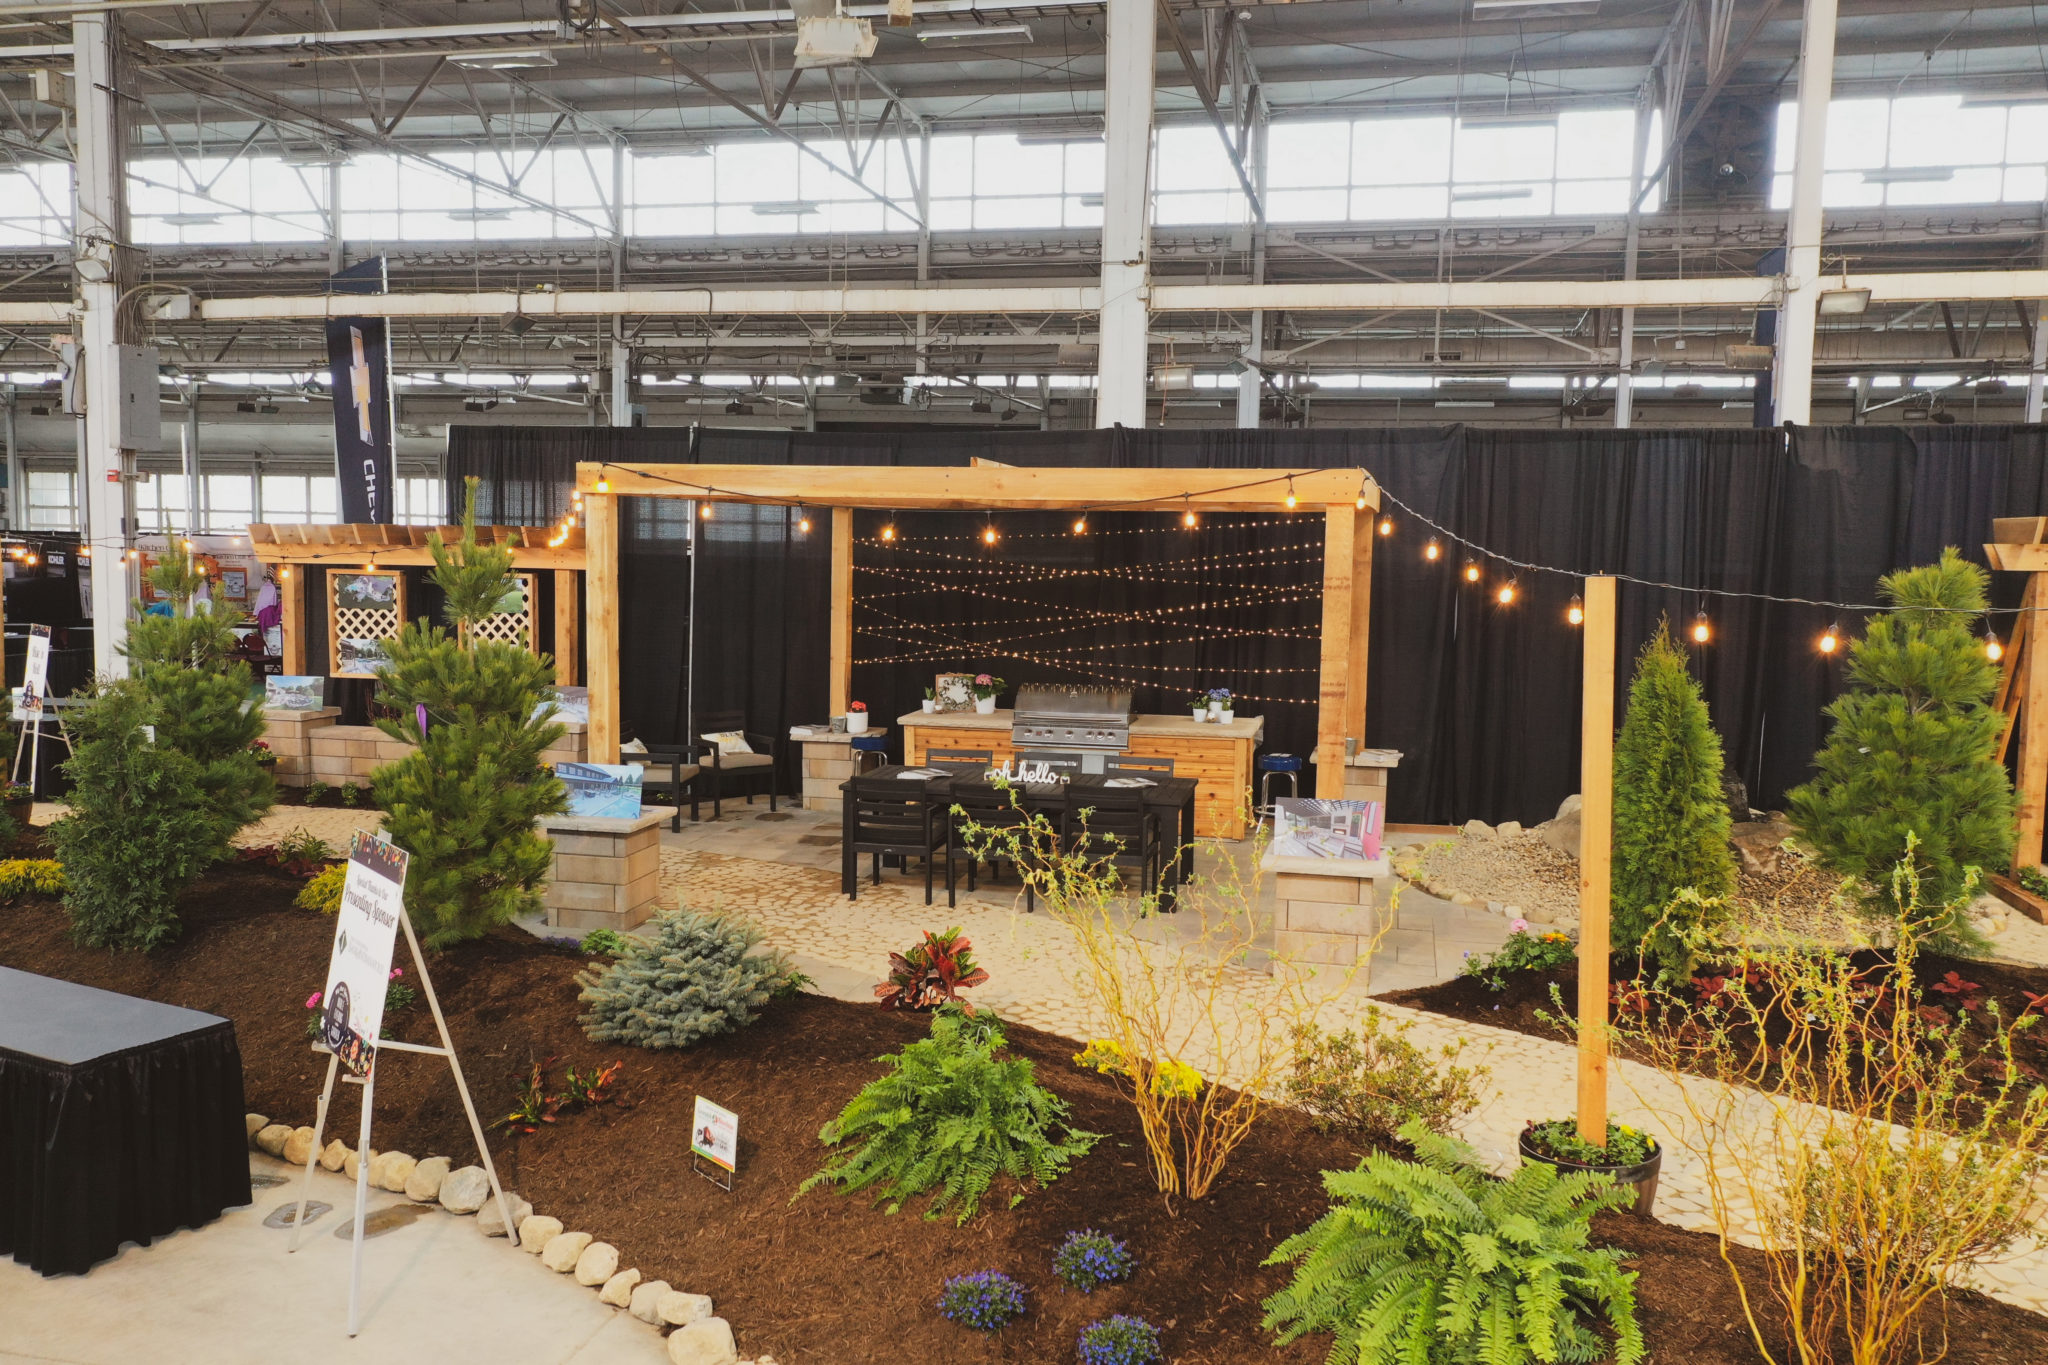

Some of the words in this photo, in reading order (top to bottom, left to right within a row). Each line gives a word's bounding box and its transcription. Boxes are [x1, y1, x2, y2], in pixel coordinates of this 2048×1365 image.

[48, 555, 64, 565] KOHLER
[993, 760, 1011, 781] oh
[1017, 761, 1059, 784] hello
[345, 883, 372, 920] Presenting
[372, 900, 395, 928] Sponsor
